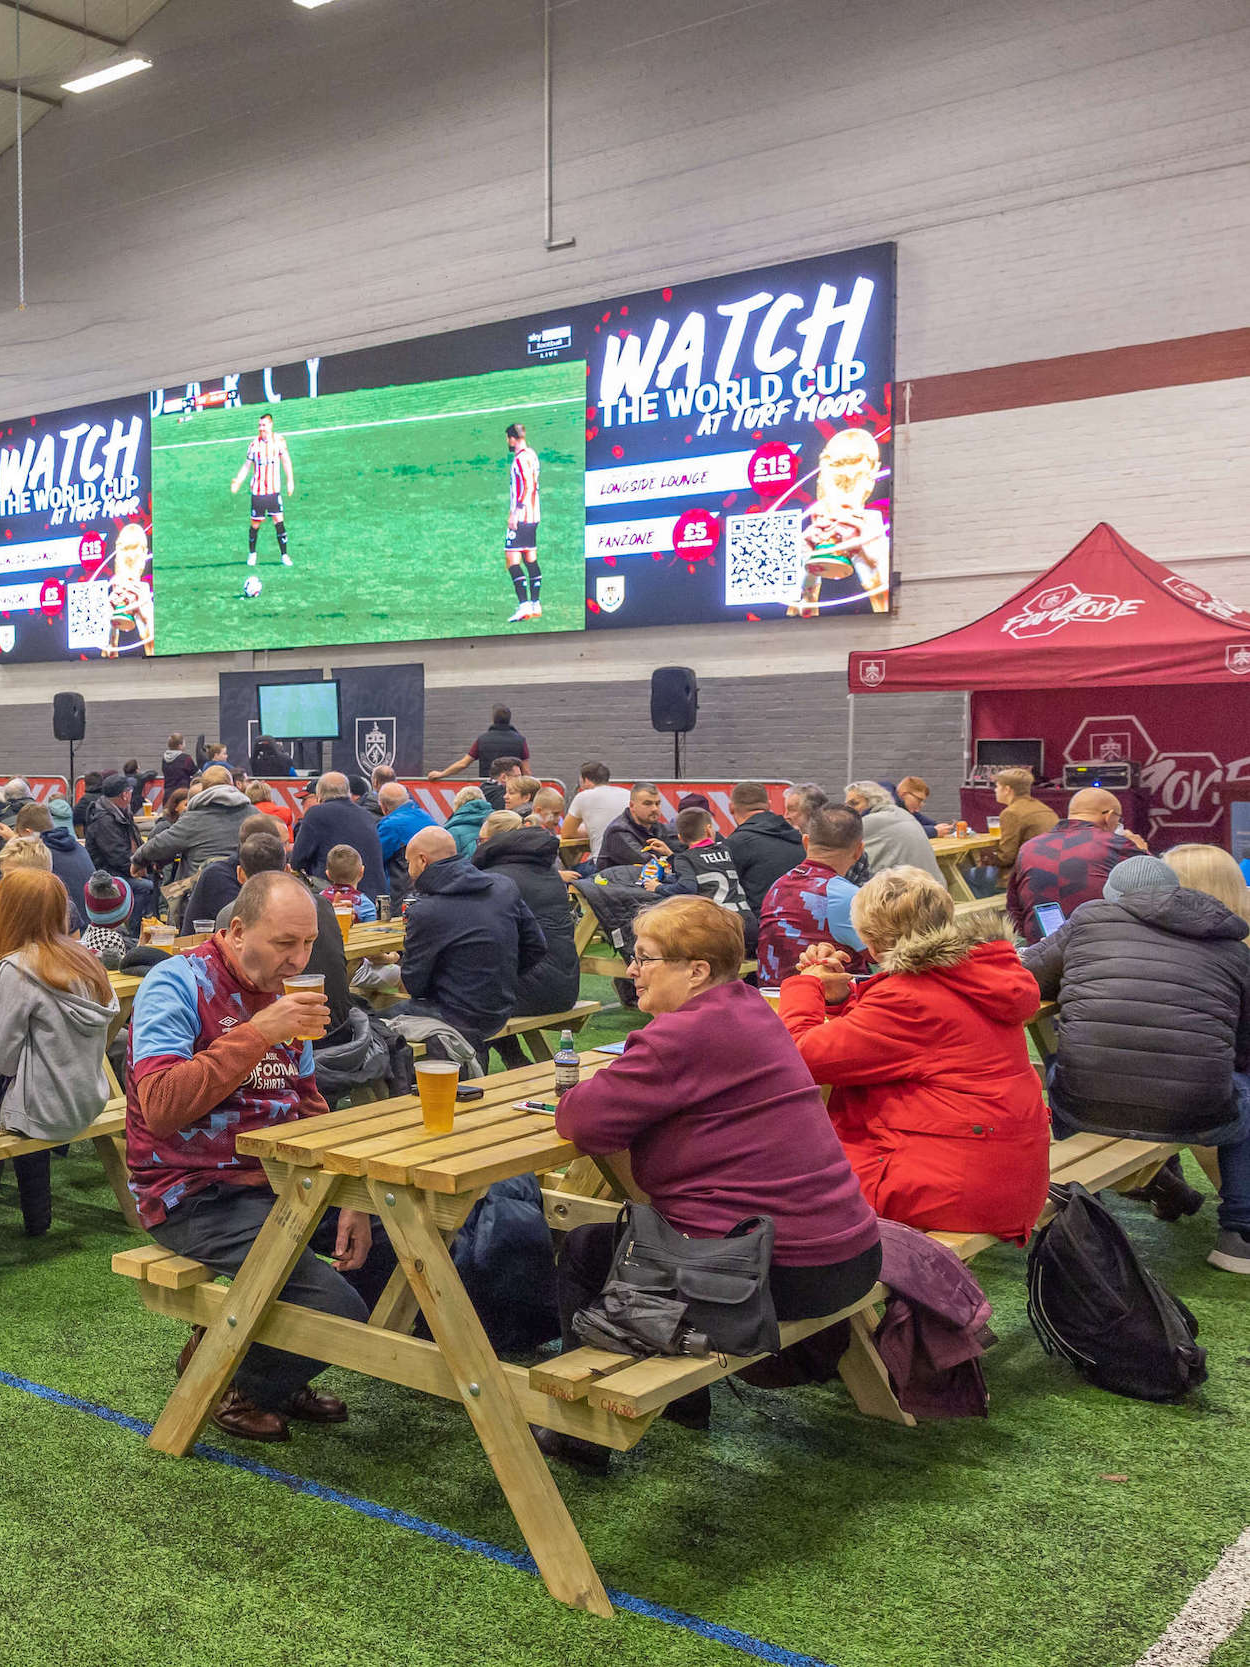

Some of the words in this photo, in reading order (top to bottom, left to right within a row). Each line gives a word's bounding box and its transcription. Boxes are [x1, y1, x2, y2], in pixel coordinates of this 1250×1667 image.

[600, 276, 875, 399] WATCH
[598, 391, 658, 427] THE
[666, 373, 783, 418] WORLD
[792, 361, 866, 398] CUP
[697, 411, 728, 436] AT
[732, 399, 793, 432] TURF
[794, 389, 867, 422] MOOR
[754, 454, 791, 476] £15
[33, 482, 97, 511] WORLD
[100, 474, 140, 500] CUP
[600, 476, 656, 496] LONGSIDE
[661, 470, 709, 488] LOUNGE
[51, 507, 68, 525] AT
[598, 530, 655, 548] FANZONE
[683, 521, 707, 541] £5
[81, 540, 102, 556] £15
[700, 850, 732, 864] TELLA
[257, 1077, 286, 1089] SHIRTS
